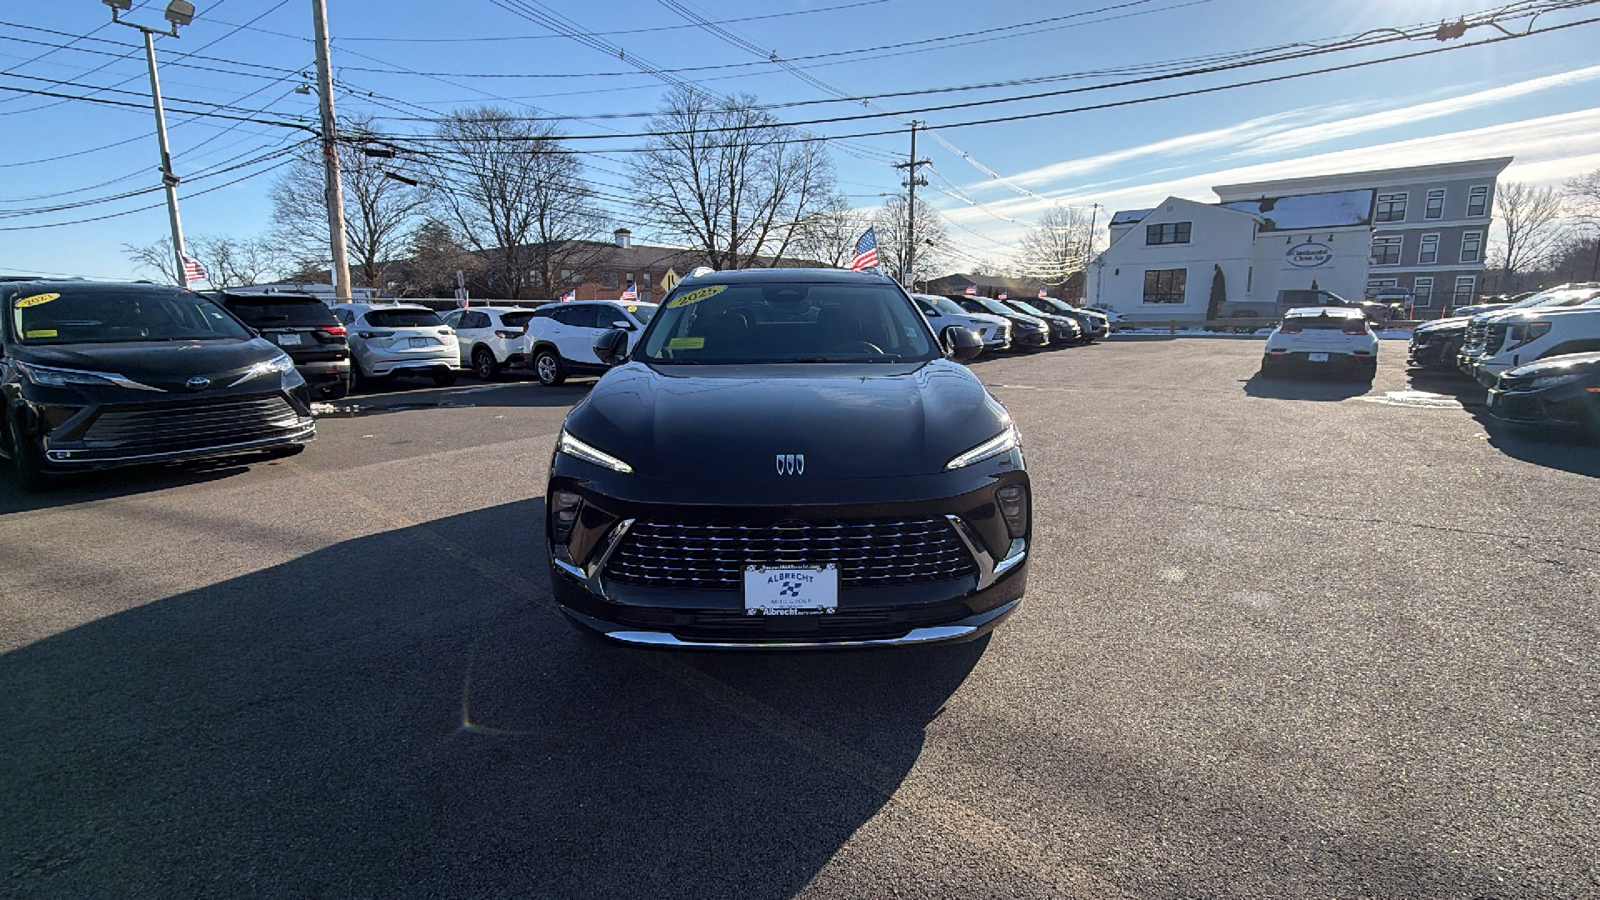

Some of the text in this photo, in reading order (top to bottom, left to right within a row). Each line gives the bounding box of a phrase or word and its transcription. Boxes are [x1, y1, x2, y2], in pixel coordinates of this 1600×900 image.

[679, 286, 717, 305] 2025
[767, 572, 814, 584] ALBRECHT
[763, 608, 798, 616] Albrecht
